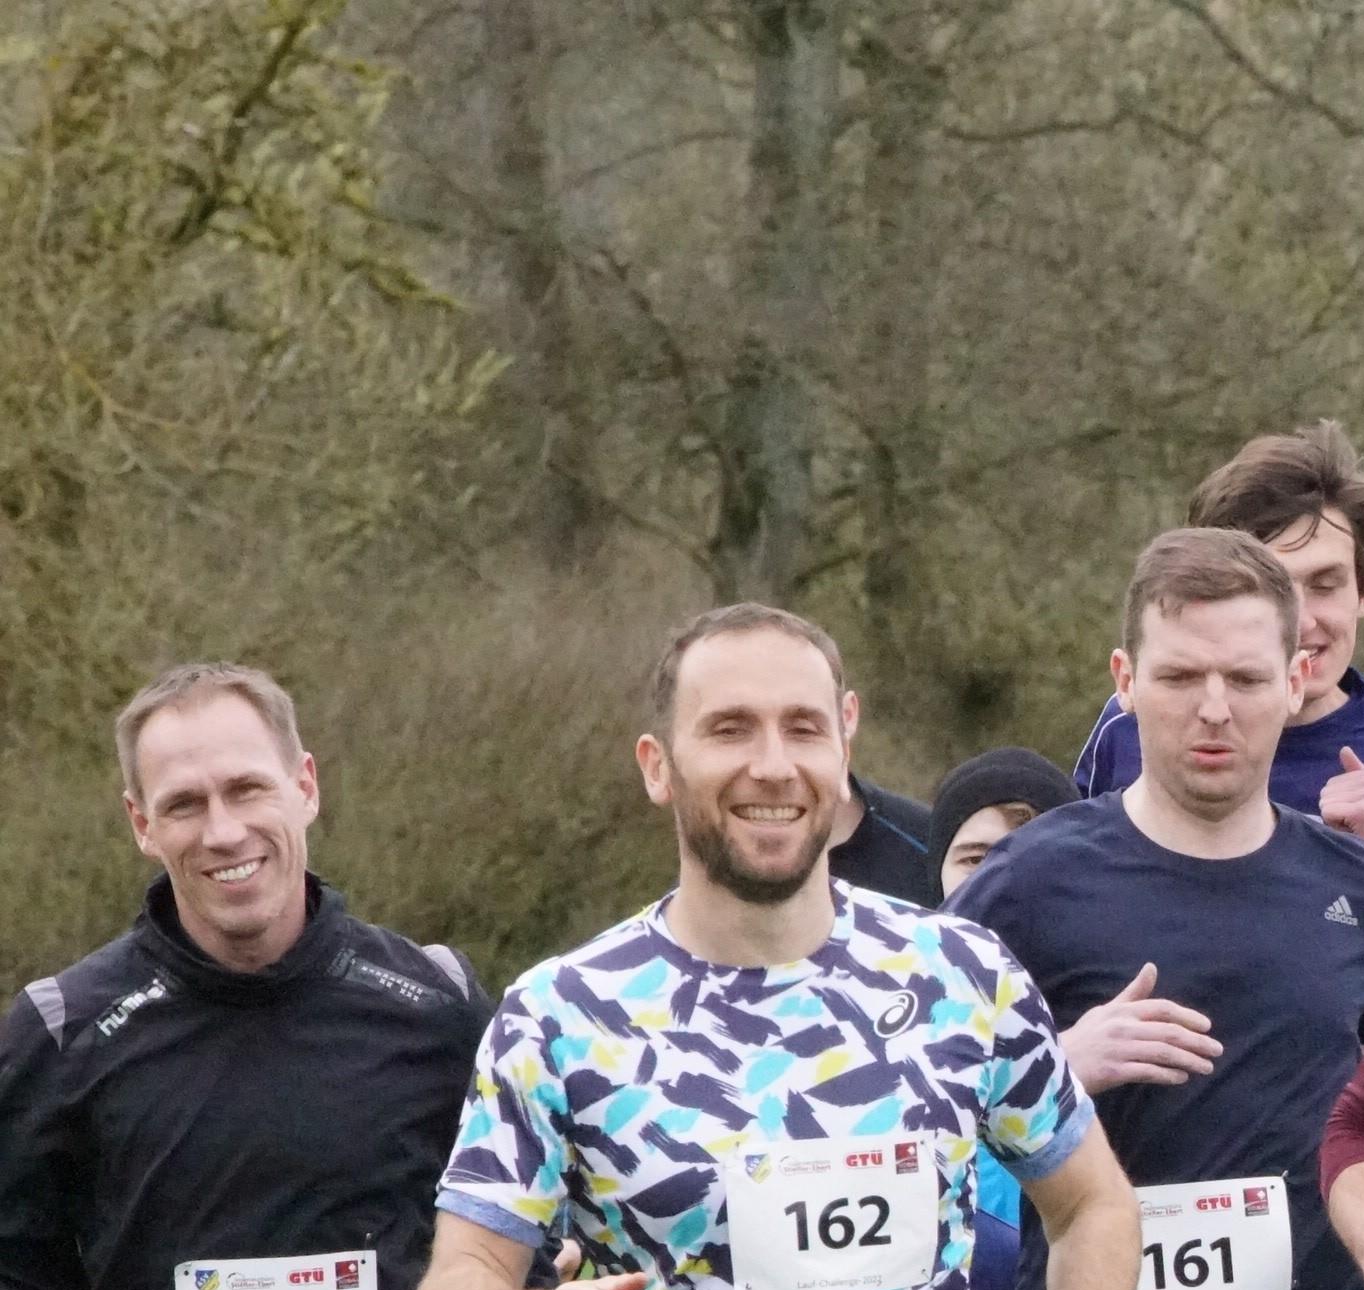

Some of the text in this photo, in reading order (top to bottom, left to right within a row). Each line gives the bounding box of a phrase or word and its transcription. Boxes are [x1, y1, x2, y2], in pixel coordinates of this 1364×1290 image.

[1324, 911, 1358, 926] adidas
[845, 1150, 883, 1168] GTÜ
[1195, 1194, 1232, 1211] GTÜ
[784, 1195, 891, 1251] 162
[1143, 1237, 1234, 1290] 161
[289, 1268, 325, 1284] GTÜ
